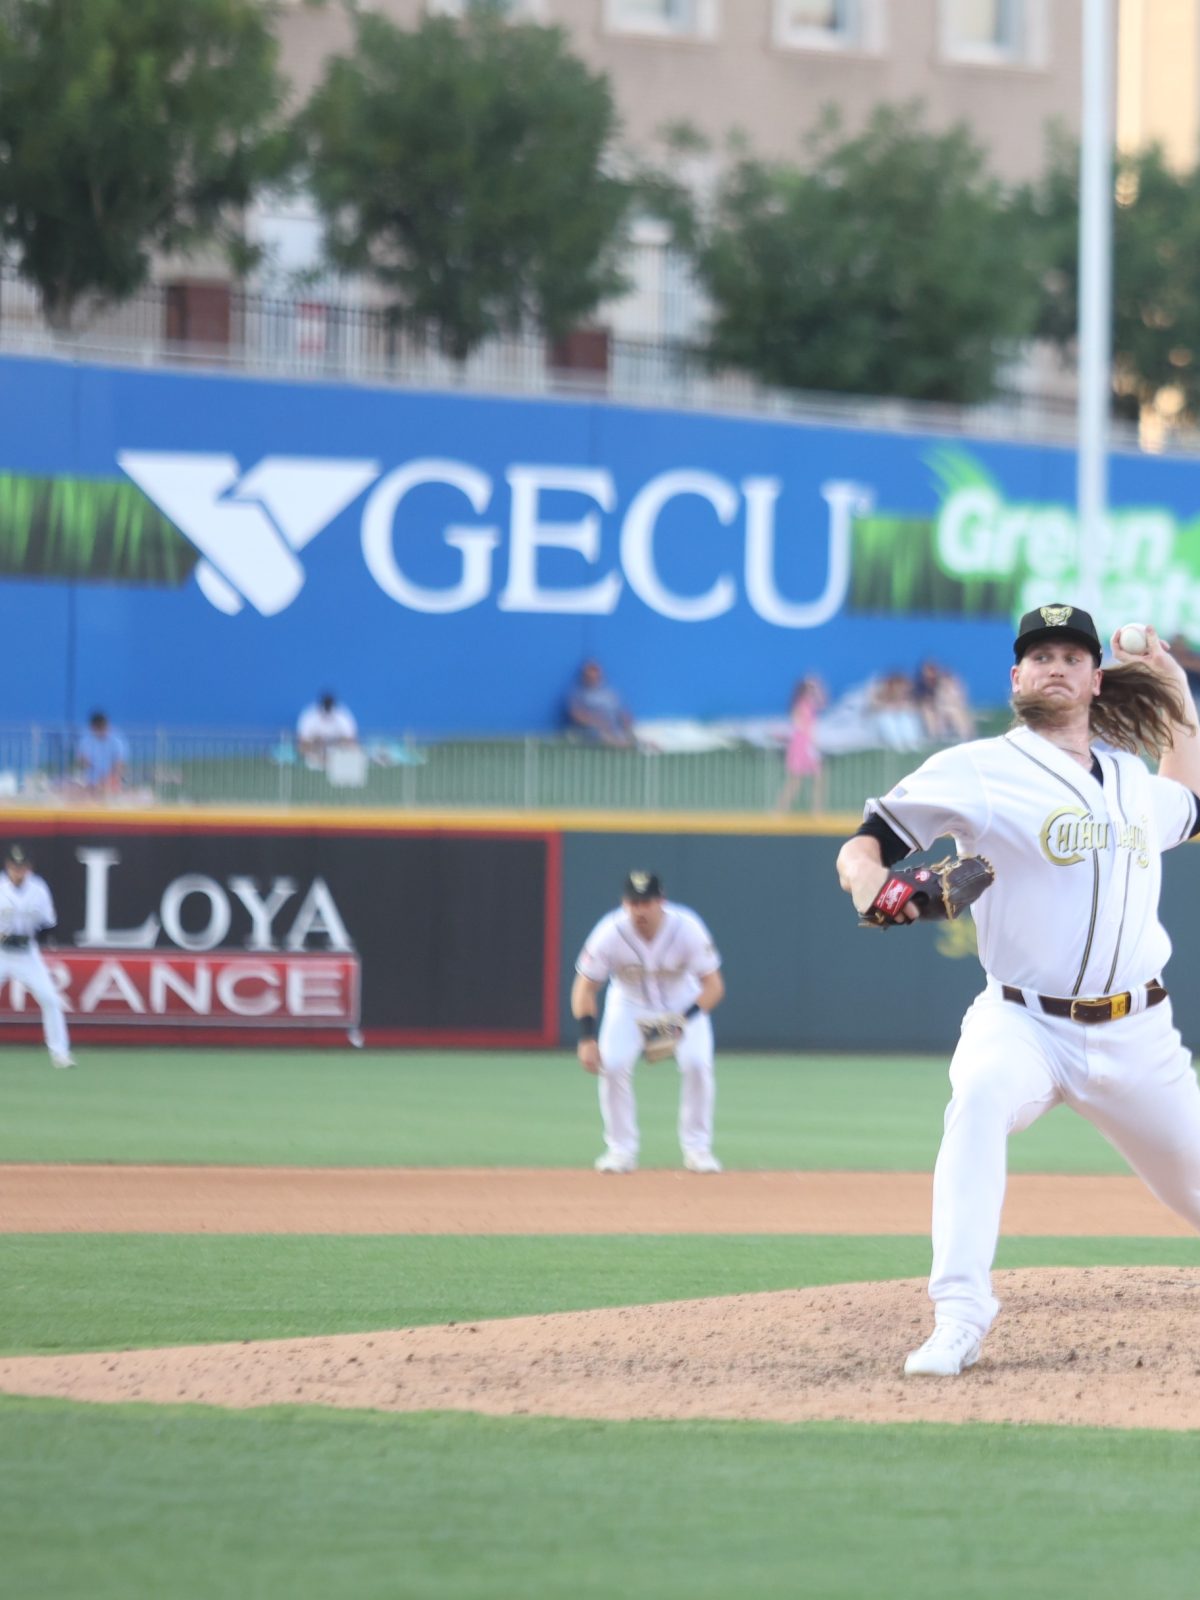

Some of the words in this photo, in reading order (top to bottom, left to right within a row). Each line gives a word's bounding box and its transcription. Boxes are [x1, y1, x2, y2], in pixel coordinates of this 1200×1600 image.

[360, 457, 855, 629] GECU
[938, 488, 1175, 579] Gren
[75, 847, 352, 951] LOYA
